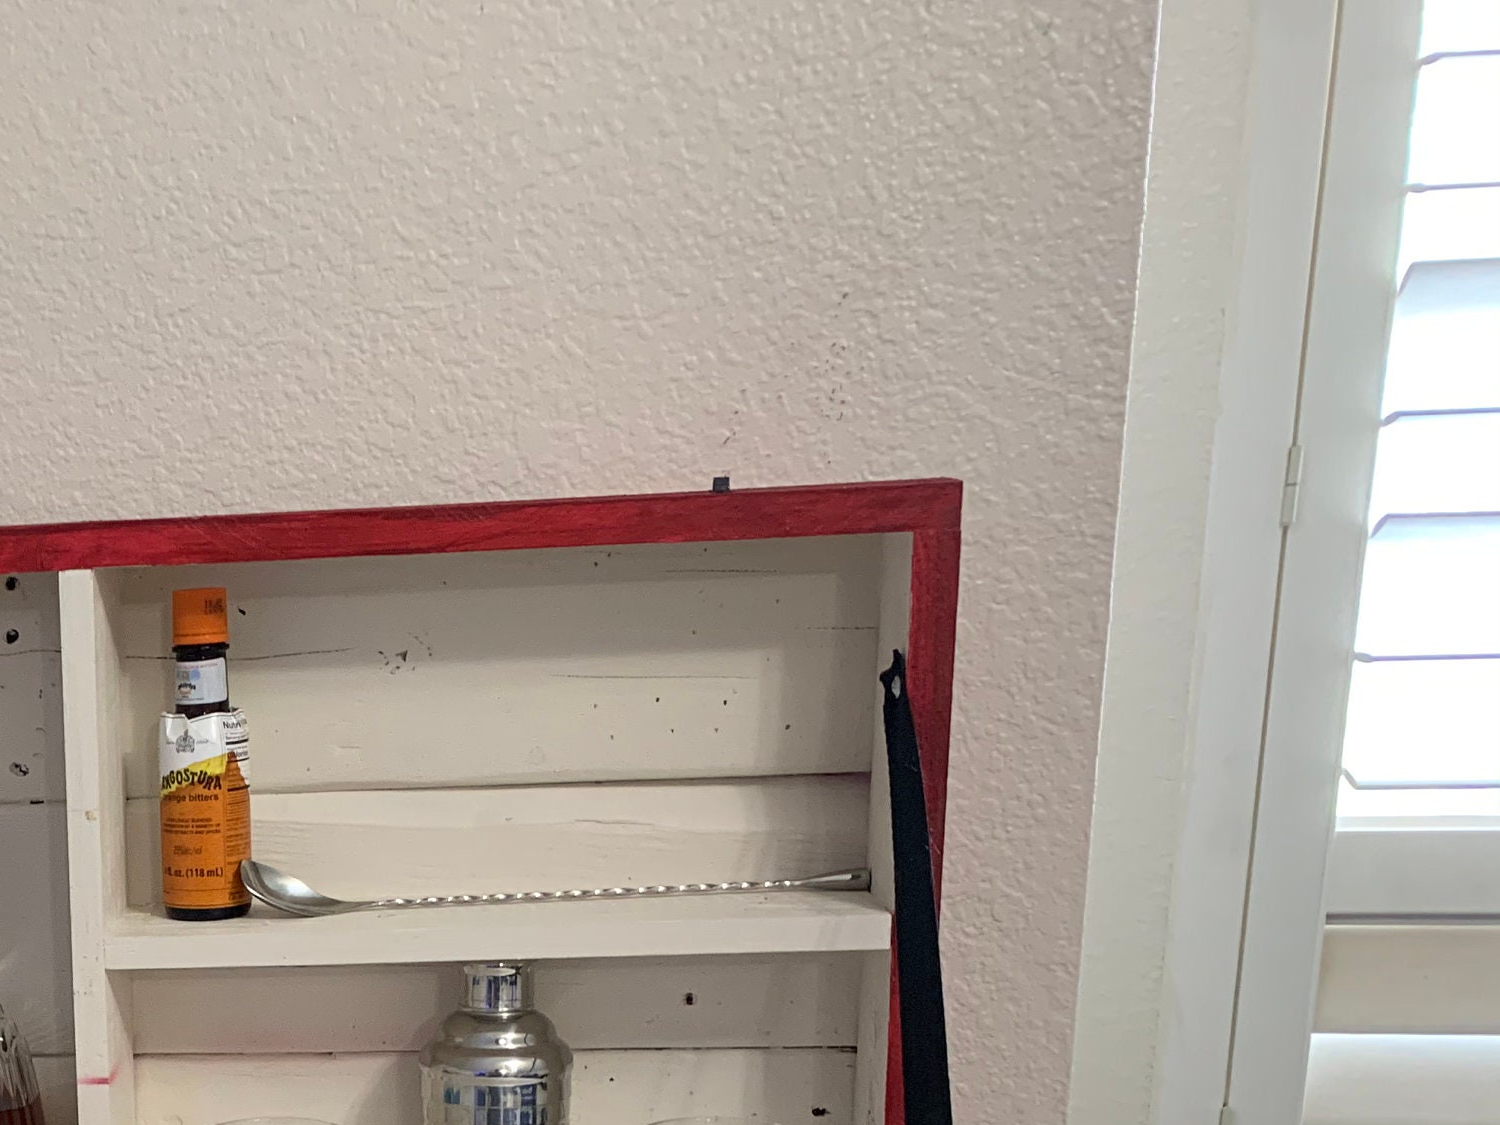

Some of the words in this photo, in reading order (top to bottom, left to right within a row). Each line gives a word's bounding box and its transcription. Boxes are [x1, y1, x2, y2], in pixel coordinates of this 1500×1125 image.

[161, 768, 222, 791] ANGOSTURA
[189, 793, 219, 802] bitters
[185, 867, 205, 879] (118
[206, 867, 224, 878] mL)
